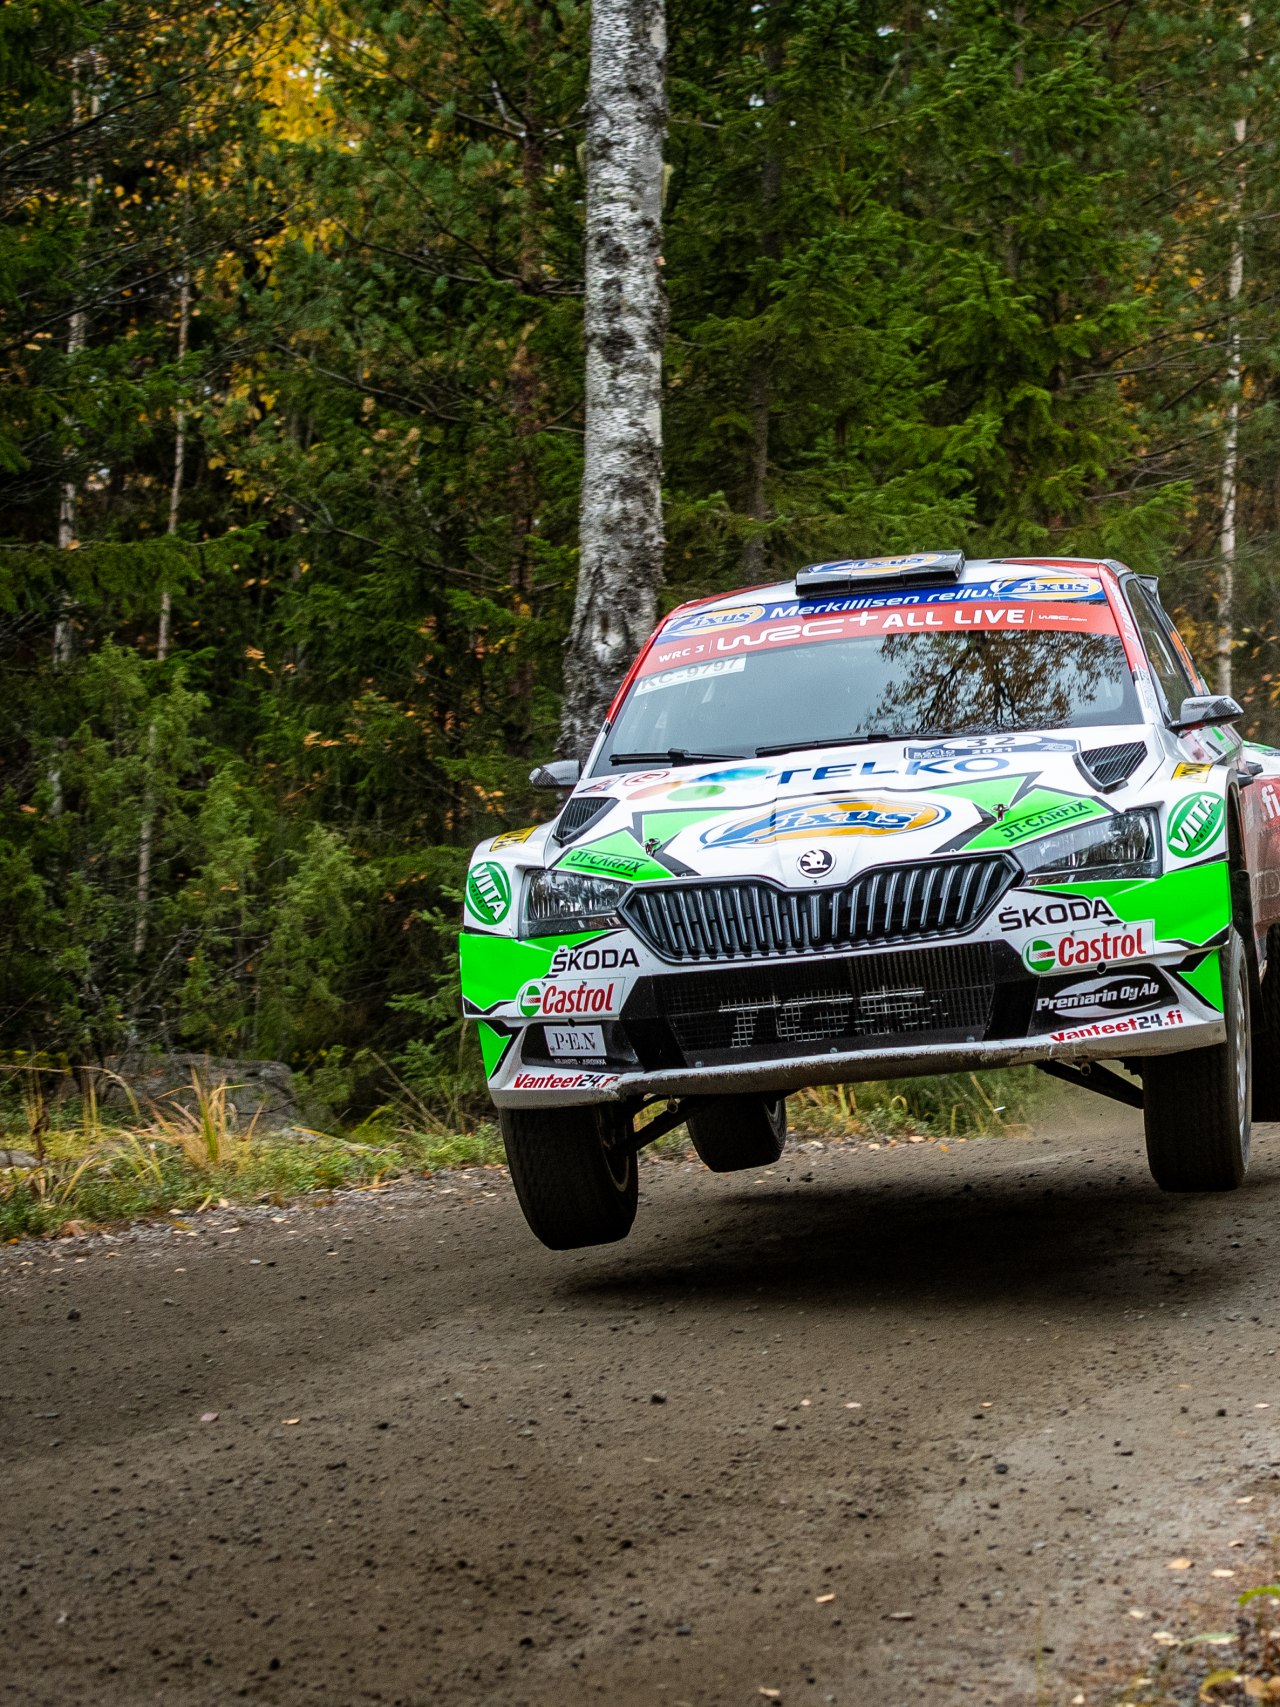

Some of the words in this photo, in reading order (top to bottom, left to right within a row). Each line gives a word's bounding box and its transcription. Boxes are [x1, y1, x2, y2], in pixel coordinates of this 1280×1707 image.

[769, 596, 918, 619] Merkillisen
[881, 611, 943, 629] ALL
[953, 609, 1026, 624] LIVE
[658, 648, 691, 663] WRC
[695, 644, 705, 654] 3
[640, 656, 741, 690] KC-9797
[966, 736, 1016, 748] 32
[971, 747, 1012, 755] 2021
[765, 756, 1010, 785] TELKO
[1169, 795, 1221, 852] VIITA
[471, 863, 507, 922] VIITA
[998, 899, 1115, 932] ŠKODA
[551, 948, 641, 973] ŠKODA
[1058, 927, 1147, 967] Castrol
[542, 982, 615, 1015] Castrol
[1036, 988, 1118, 1012] Premarin
[1120, 985, 1139, 1001] Oy
[1139, 982, 1160, 996] Ab
